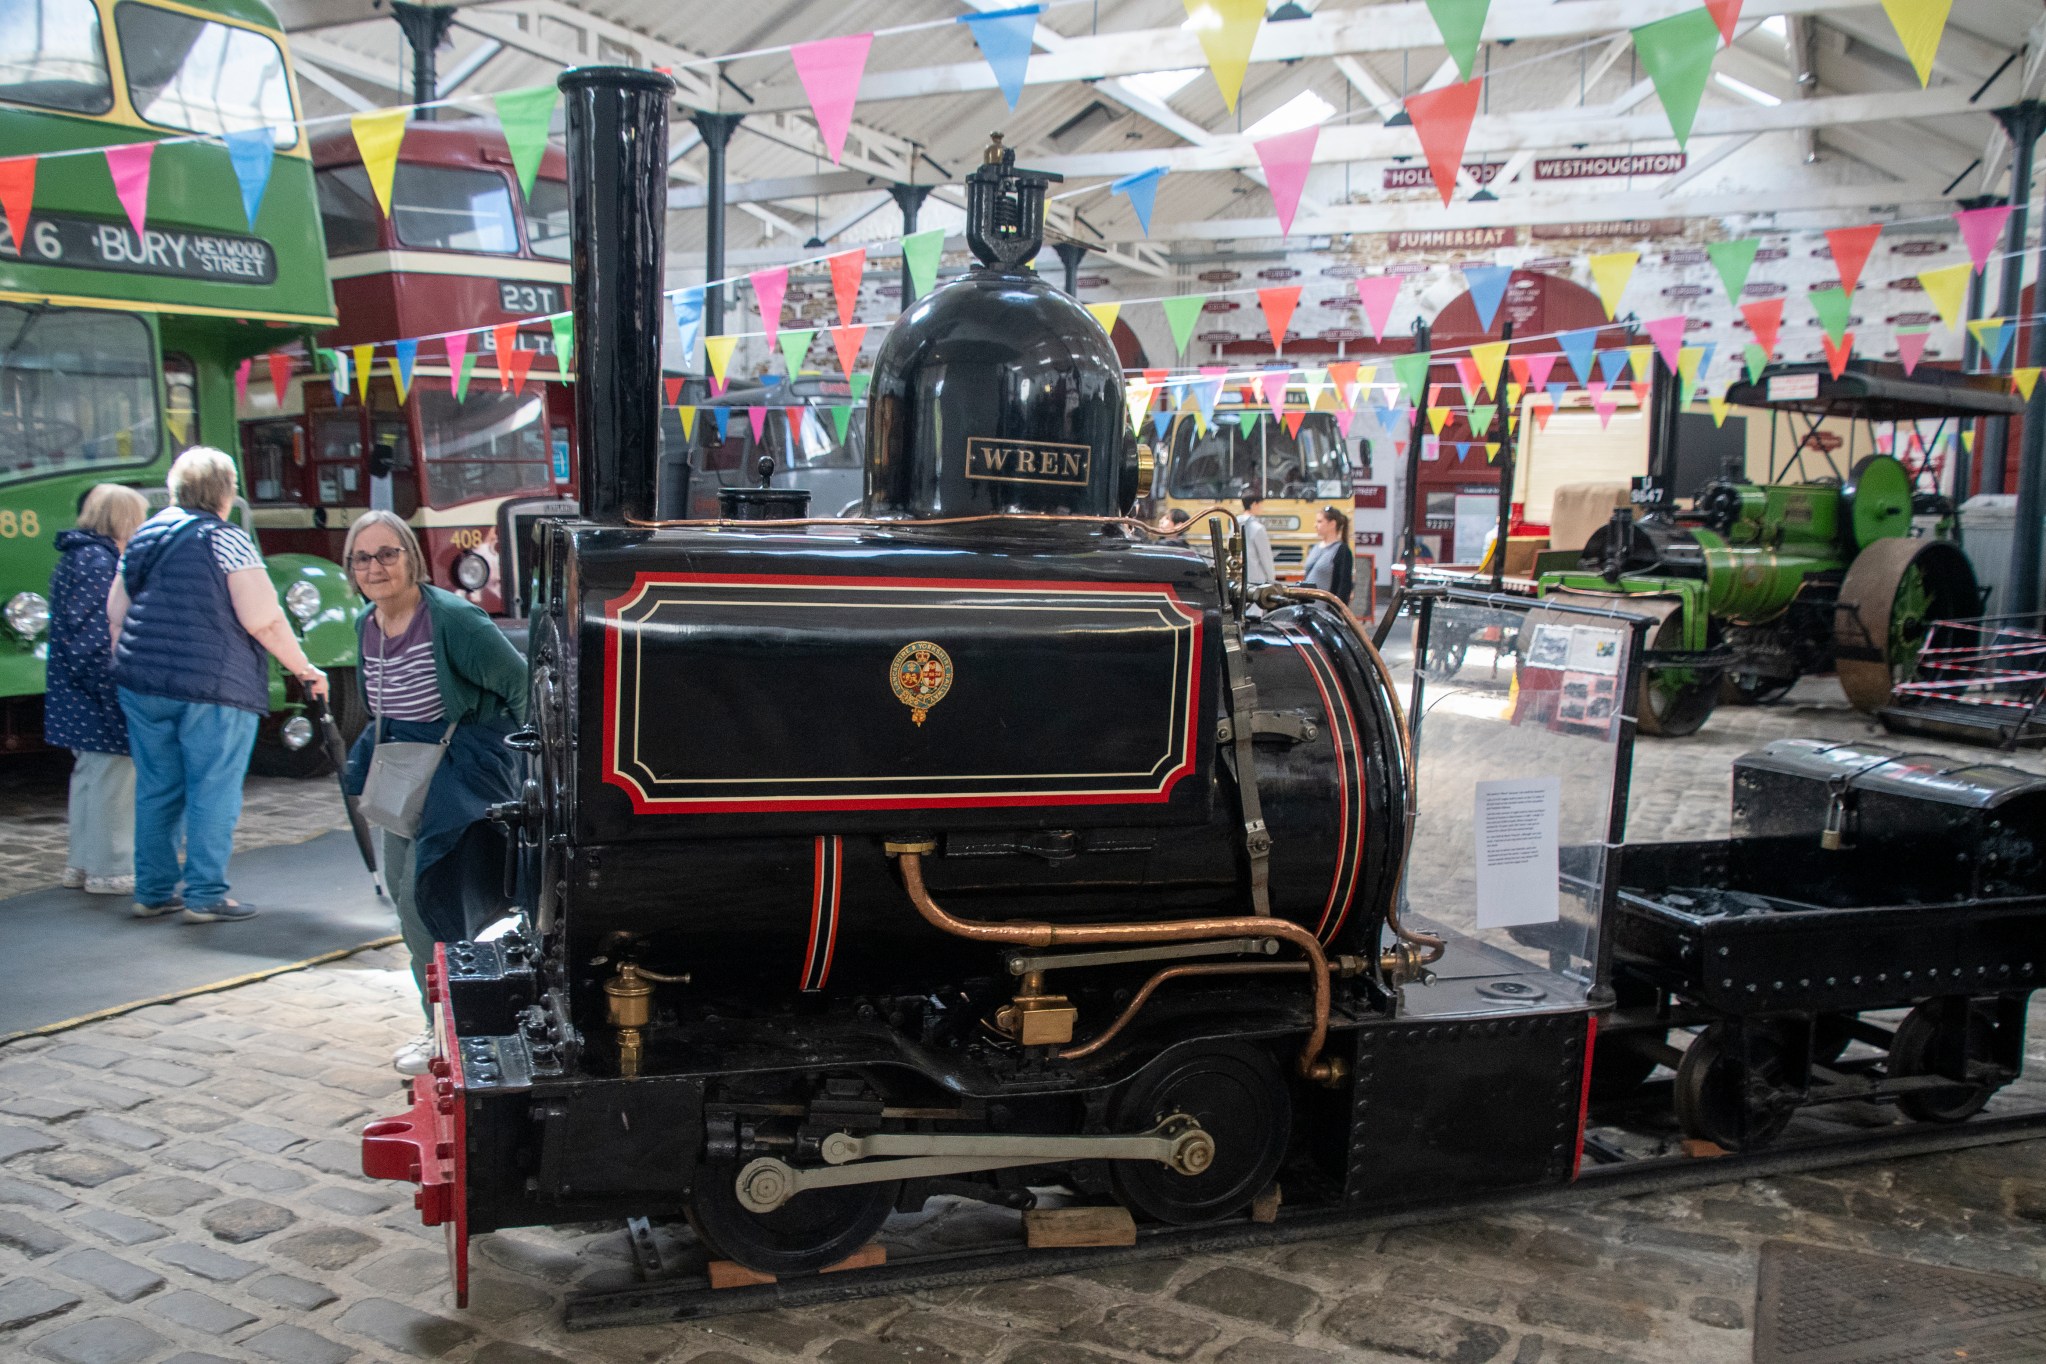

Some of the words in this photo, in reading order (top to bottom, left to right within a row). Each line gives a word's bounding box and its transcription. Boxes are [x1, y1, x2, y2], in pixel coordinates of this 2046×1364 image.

[1538, 154, 1683, 178] WESTHOUGHTON
[196, 236, 266, 260] HEYWOOD
[1400, 228, 1506, 248] SUMMERSEAT
[201, 255, 265, 277] STREET
[502, 284, 553, 314] 23T
[981, 447, 1081, 477] WREN
[451, 529, 483, 549] 408
[918, 643, 951, 671] YORKSHIRE
